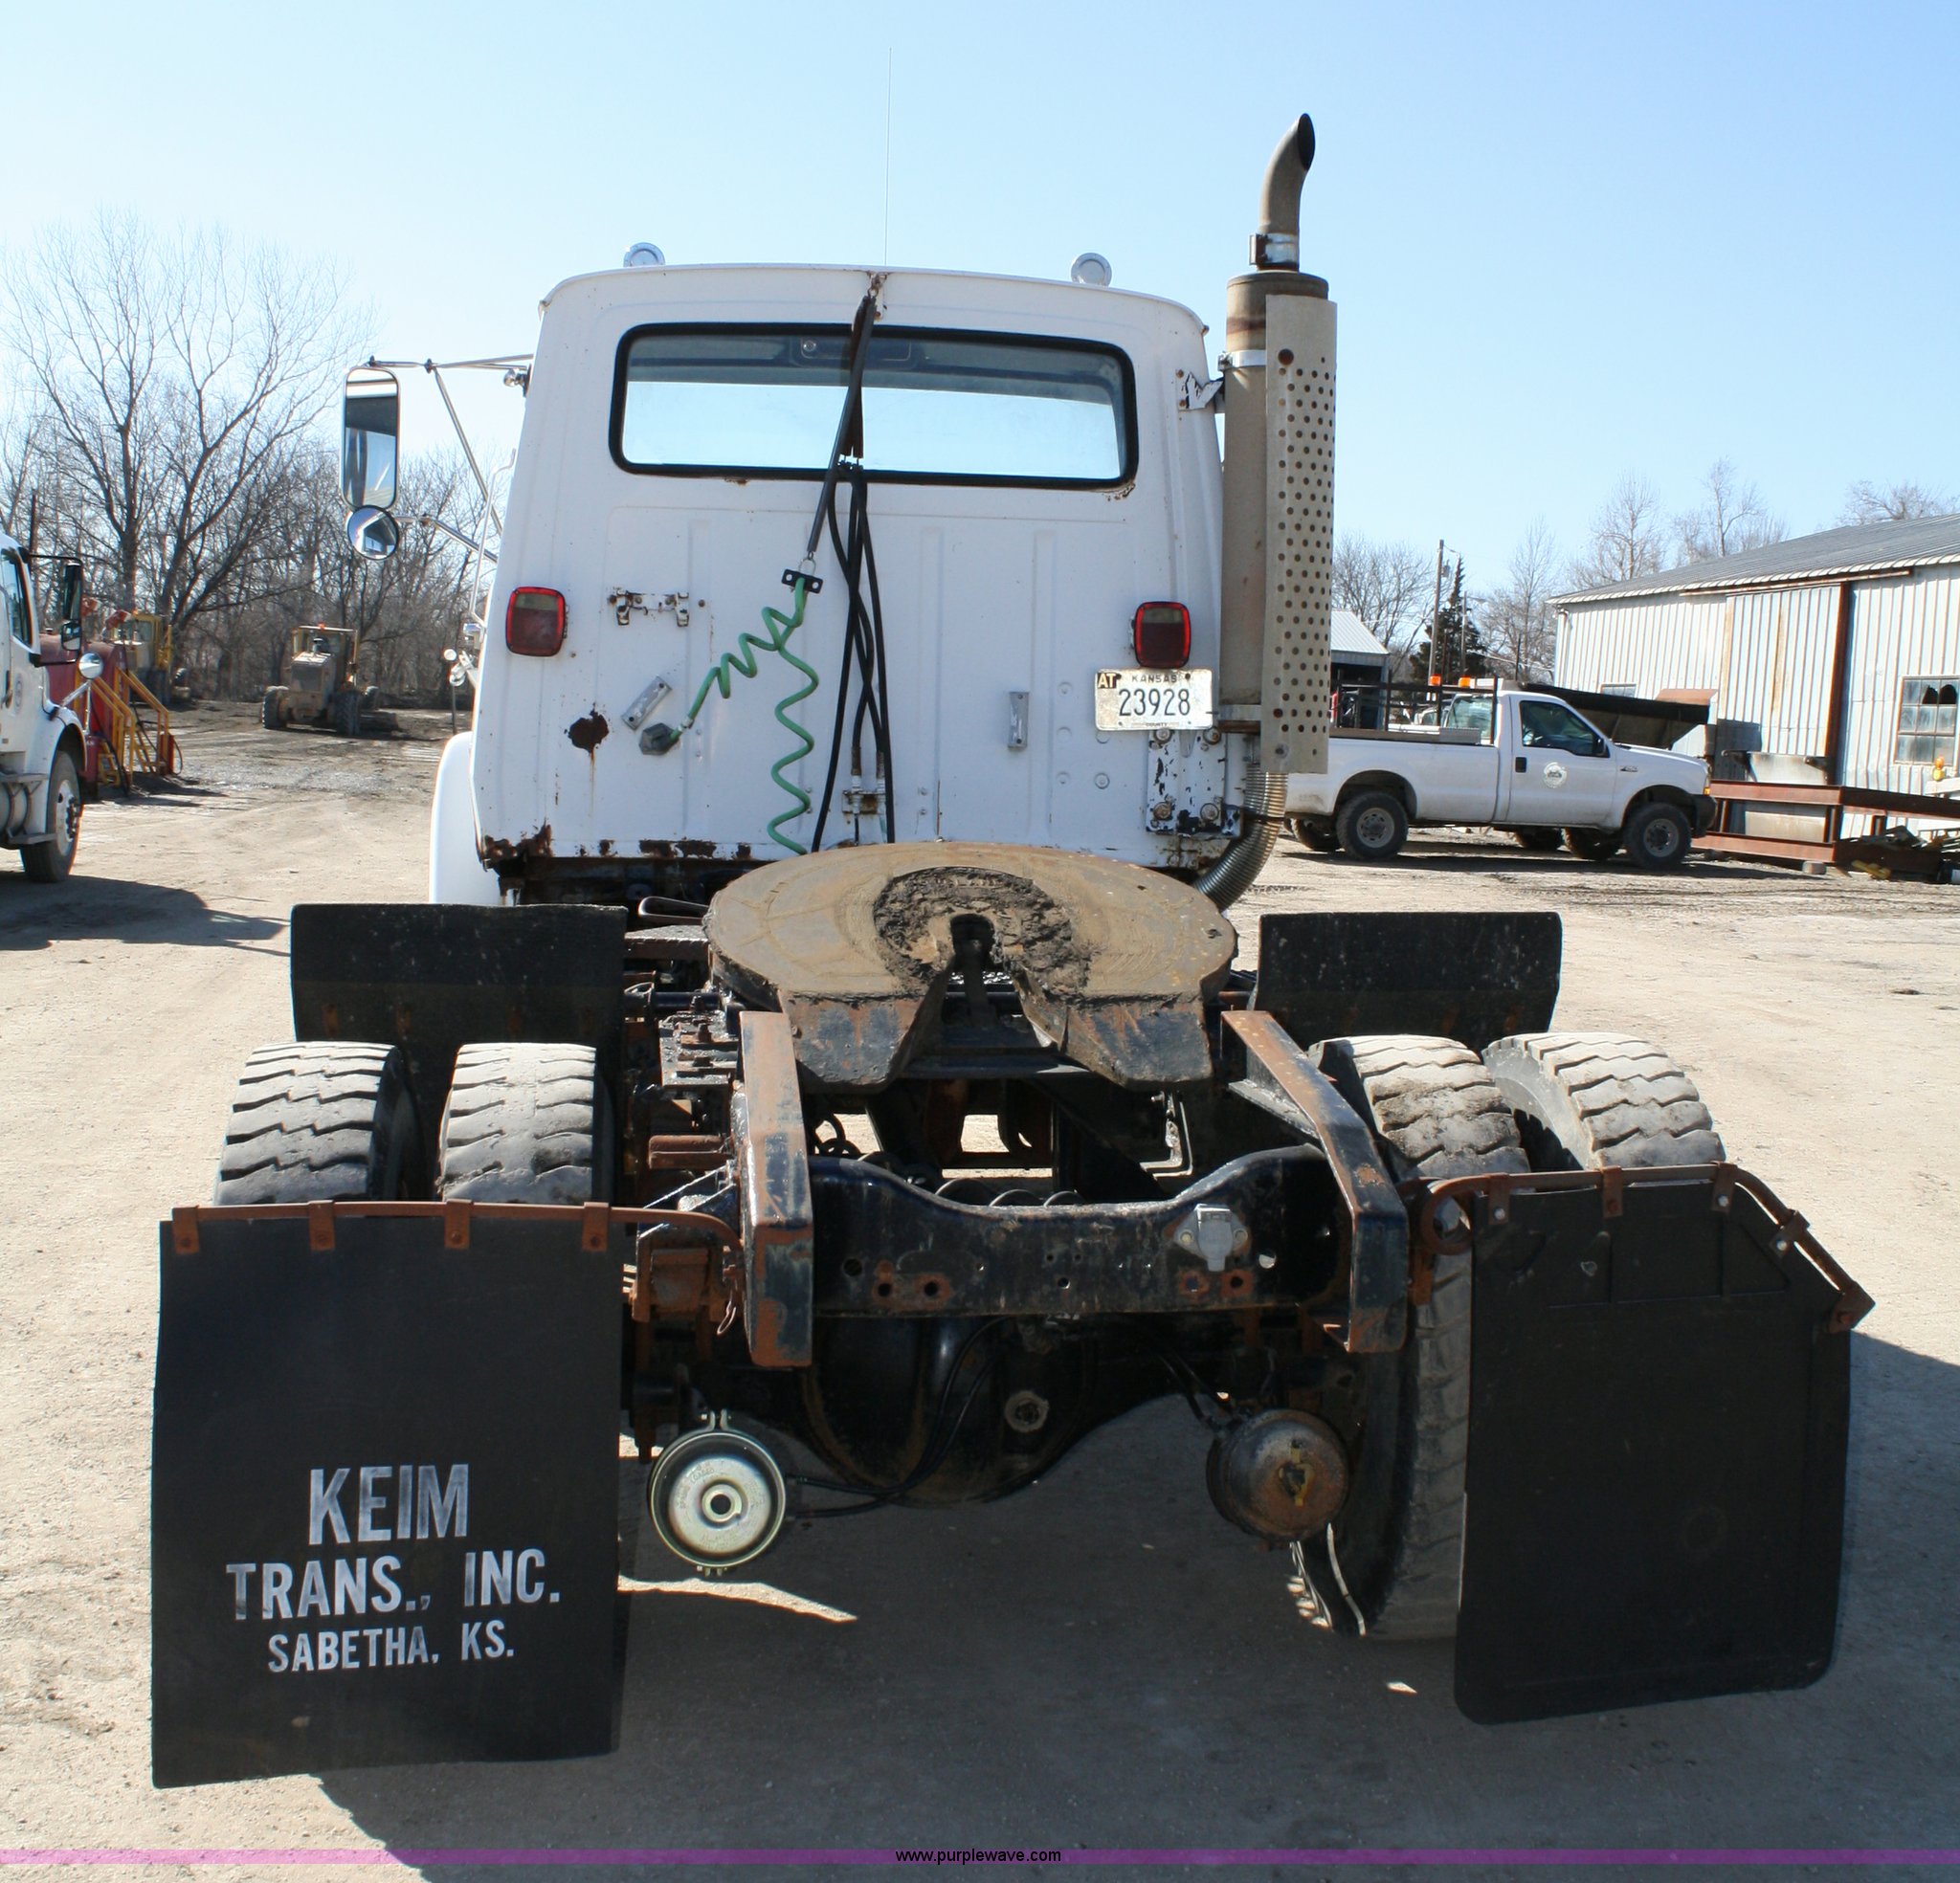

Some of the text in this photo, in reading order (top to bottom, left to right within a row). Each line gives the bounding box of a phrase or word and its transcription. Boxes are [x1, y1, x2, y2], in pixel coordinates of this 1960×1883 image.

[1098, 673, 1117, 688] AT
[1132, 674, 1178, 683] KANSAS
[1118, 688, 1192, 717] 23928
[308, 1463, 470, 1545] KEIM
[464, 1548, 561, 1607] INC.
[460, 1619, 515, 1662] KS.
